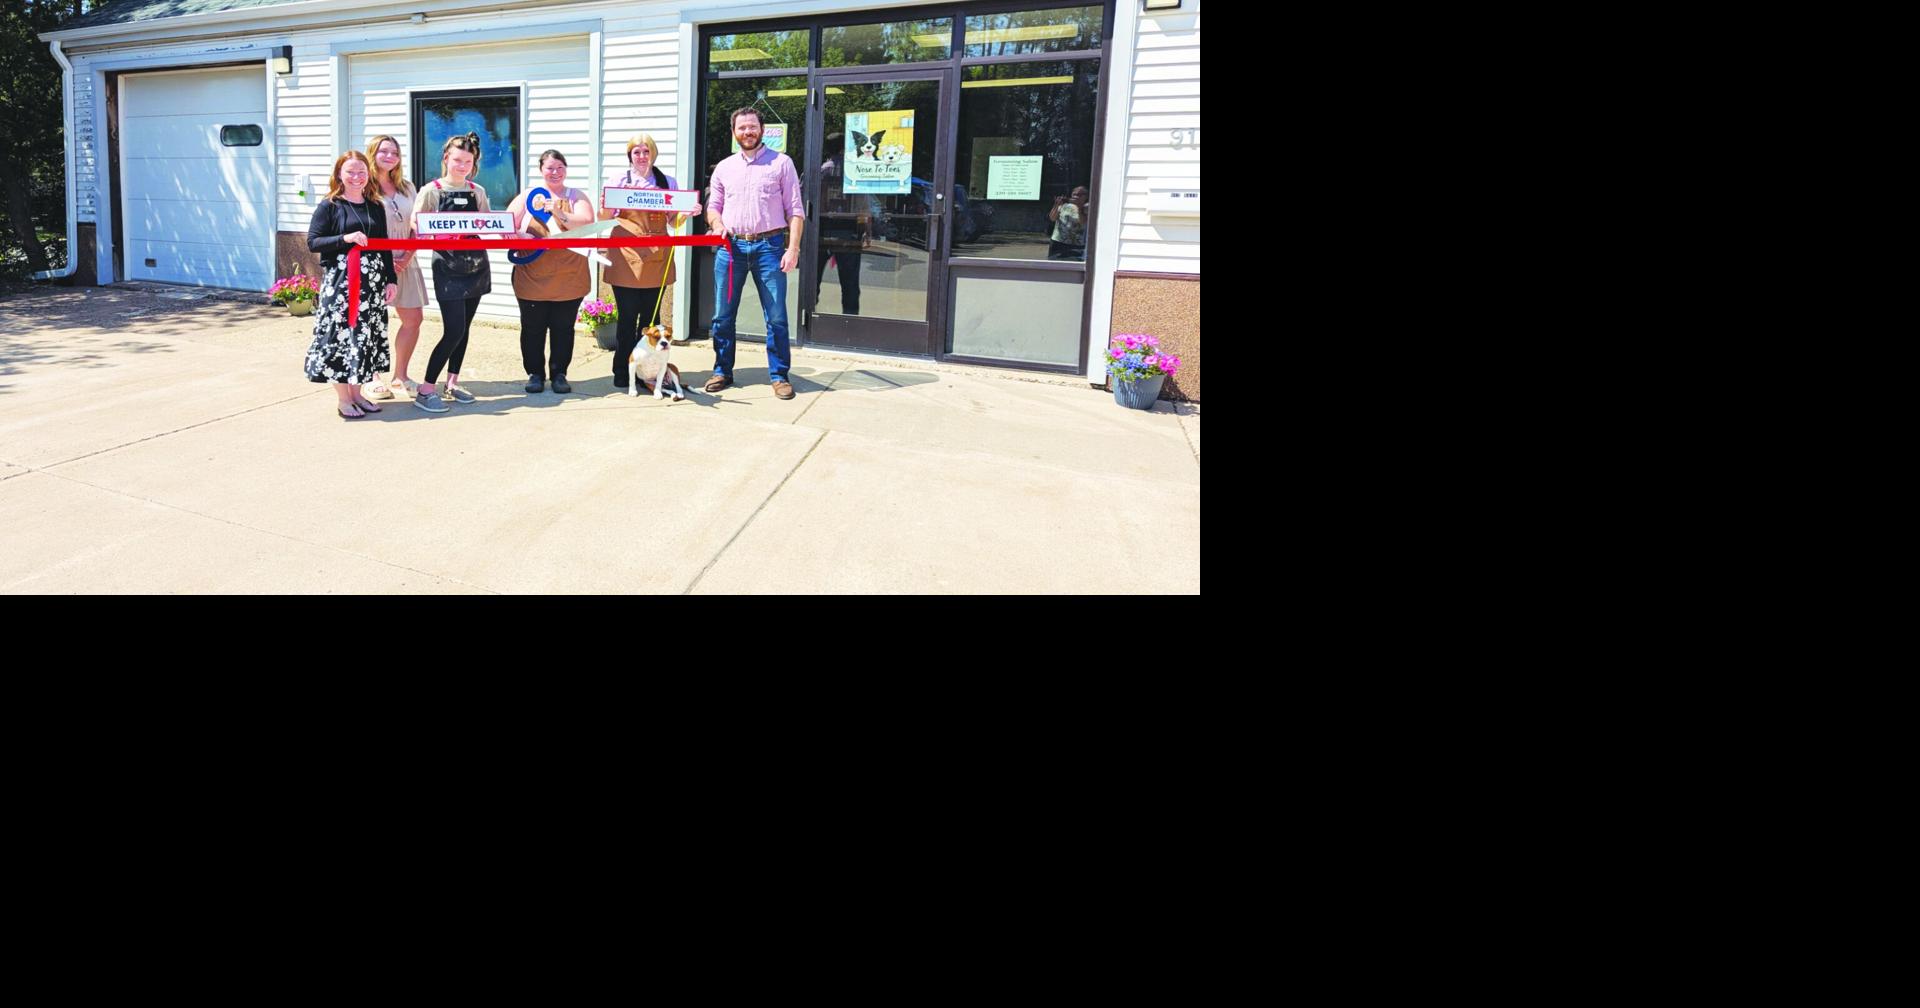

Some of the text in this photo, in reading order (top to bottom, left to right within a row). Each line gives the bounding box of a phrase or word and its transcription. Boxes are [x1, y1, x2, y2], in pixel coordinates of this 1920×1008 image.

[856, 163, 901, 173] Nose To Toes
[626, 196, 664, 205] CHAMBER
[428, 220, 456, 229] KEEP
[459, 220, 468, 229] IT
